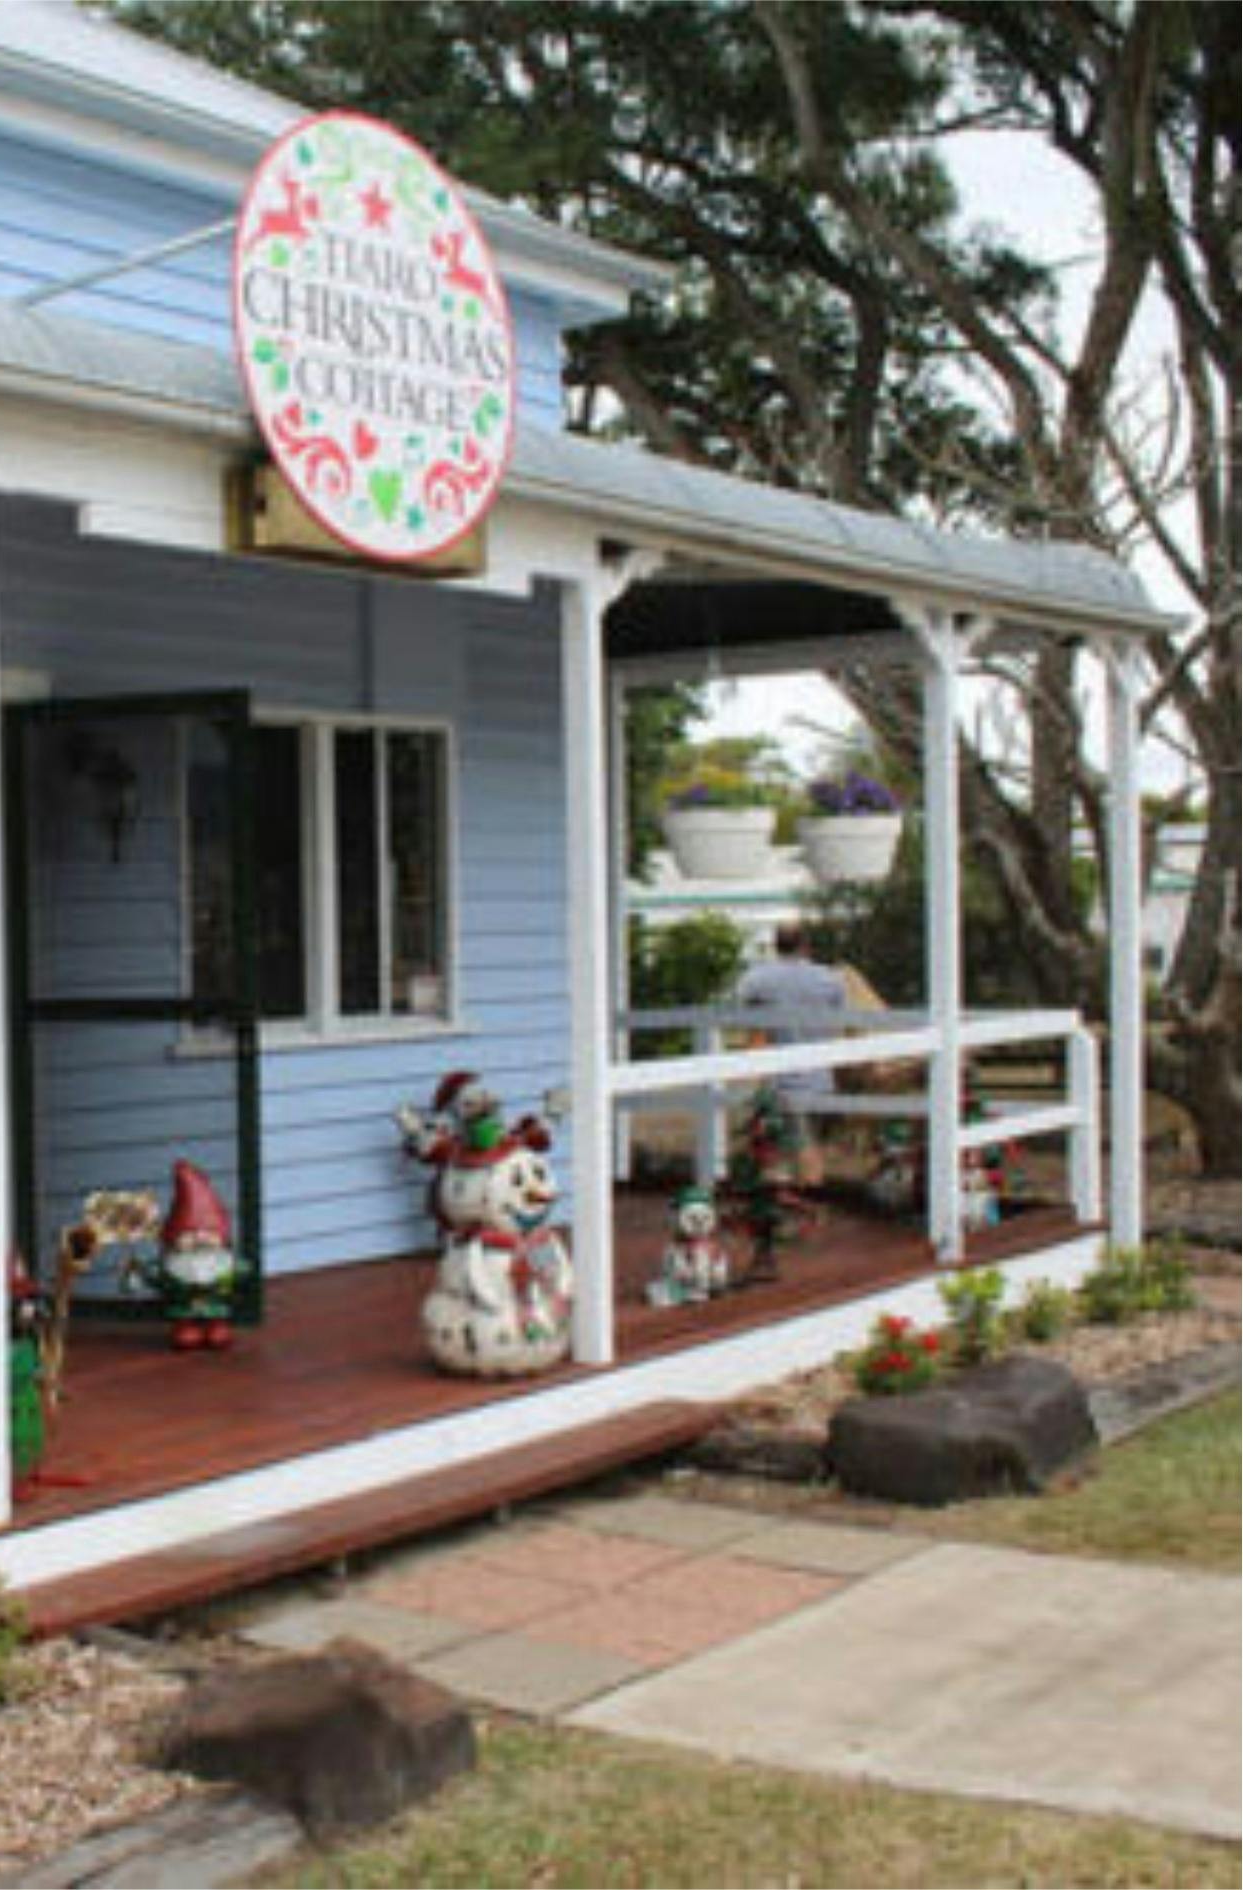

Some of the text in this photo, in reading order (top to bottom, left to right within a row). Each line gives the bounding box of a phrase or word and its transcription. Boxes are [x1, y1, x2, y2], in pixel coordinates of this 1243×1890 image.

[323, 231, 438, 303] TIARO
[243, 268, 506, 381] CHRISTMAS
[296, 356, 468, 431] COTTAGE
